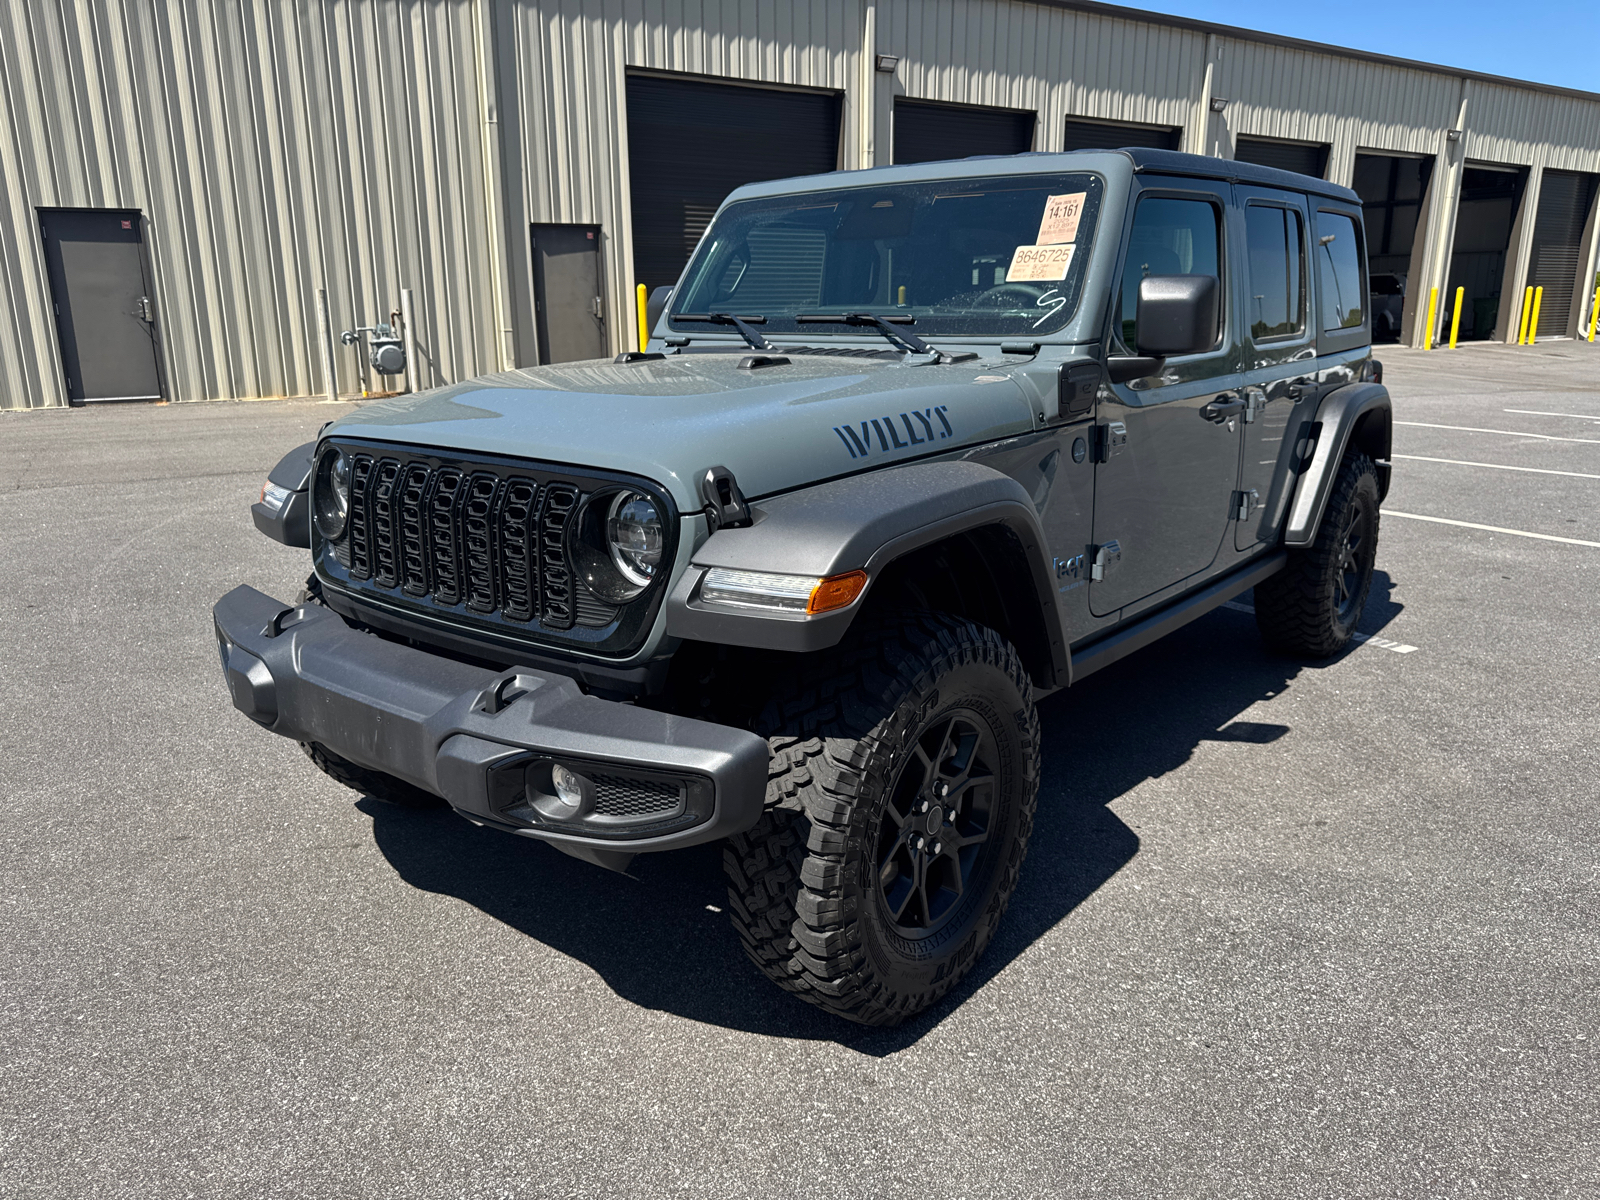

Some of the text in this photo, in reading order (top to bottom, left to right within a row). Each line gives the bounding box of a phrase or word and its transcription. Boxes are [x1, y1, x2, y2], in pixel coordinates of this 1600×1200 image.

[1050, 203, 1079, 219] 14:161
[1015, 248, 1071, 264] 8646725
[832, 405, 953, 459] WILLYS
[986, 709, 1034, 928] WILDPEAK
[930, 929, 978, 986] M/T
